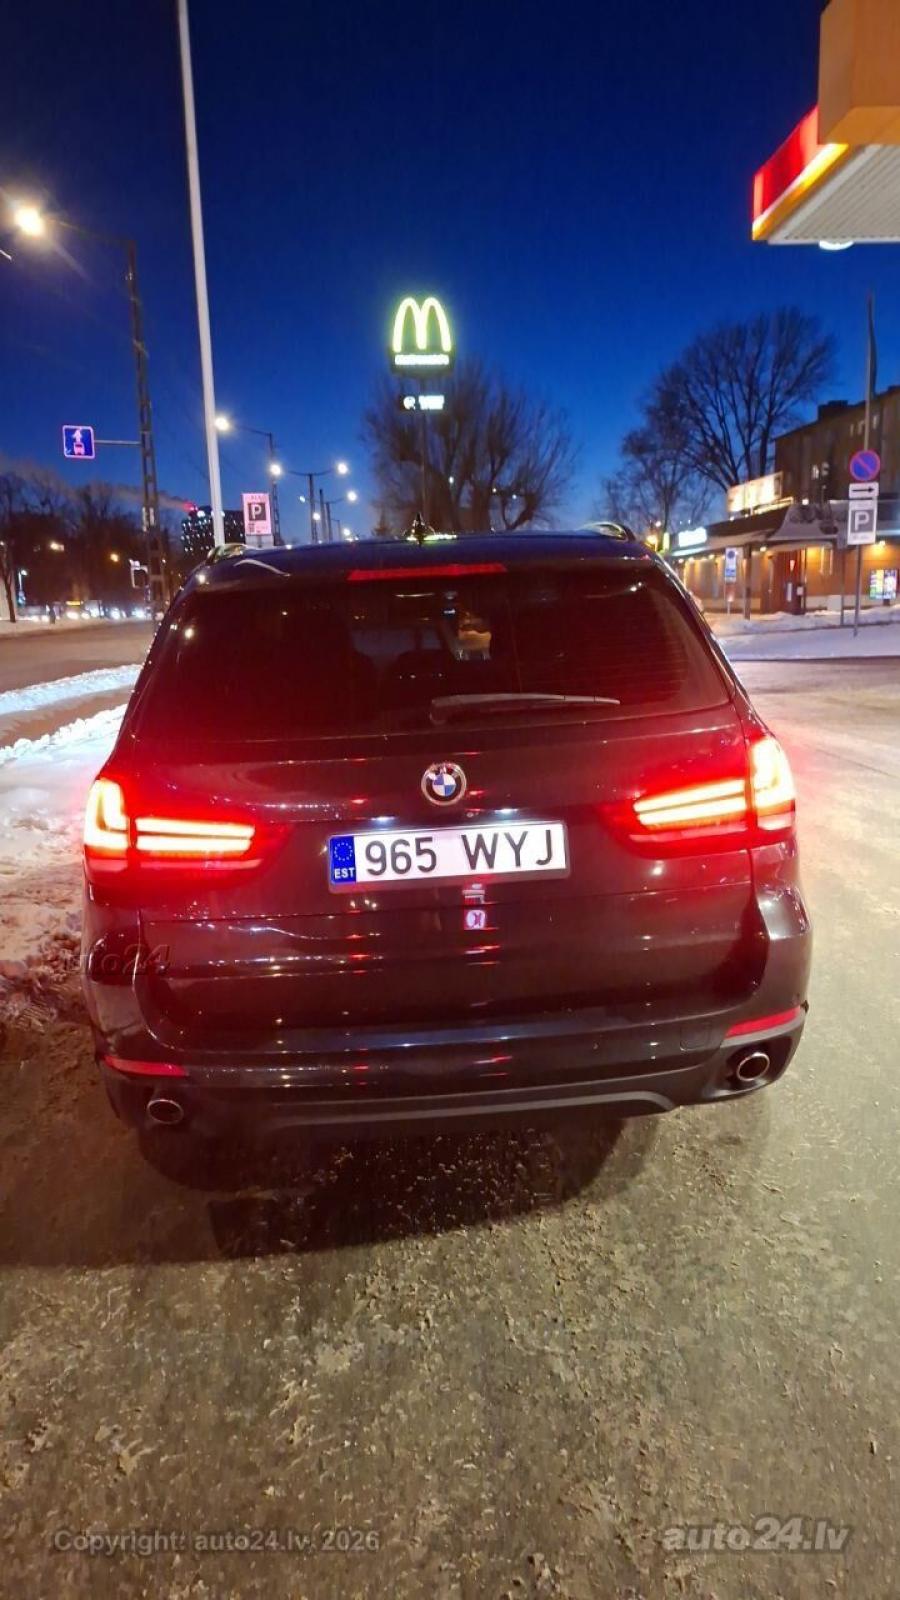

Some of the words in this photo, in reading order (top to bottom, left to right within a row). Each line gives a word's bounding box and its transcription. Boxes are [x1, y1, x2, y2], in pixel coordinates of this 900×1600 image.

[251, 504, 262, 520] P
[855, 511, 870, 532] P
[364, 836, 437, 876] 965
[461, 829, 553, 871] WYJ
[334, 867, 355, 880] EST
